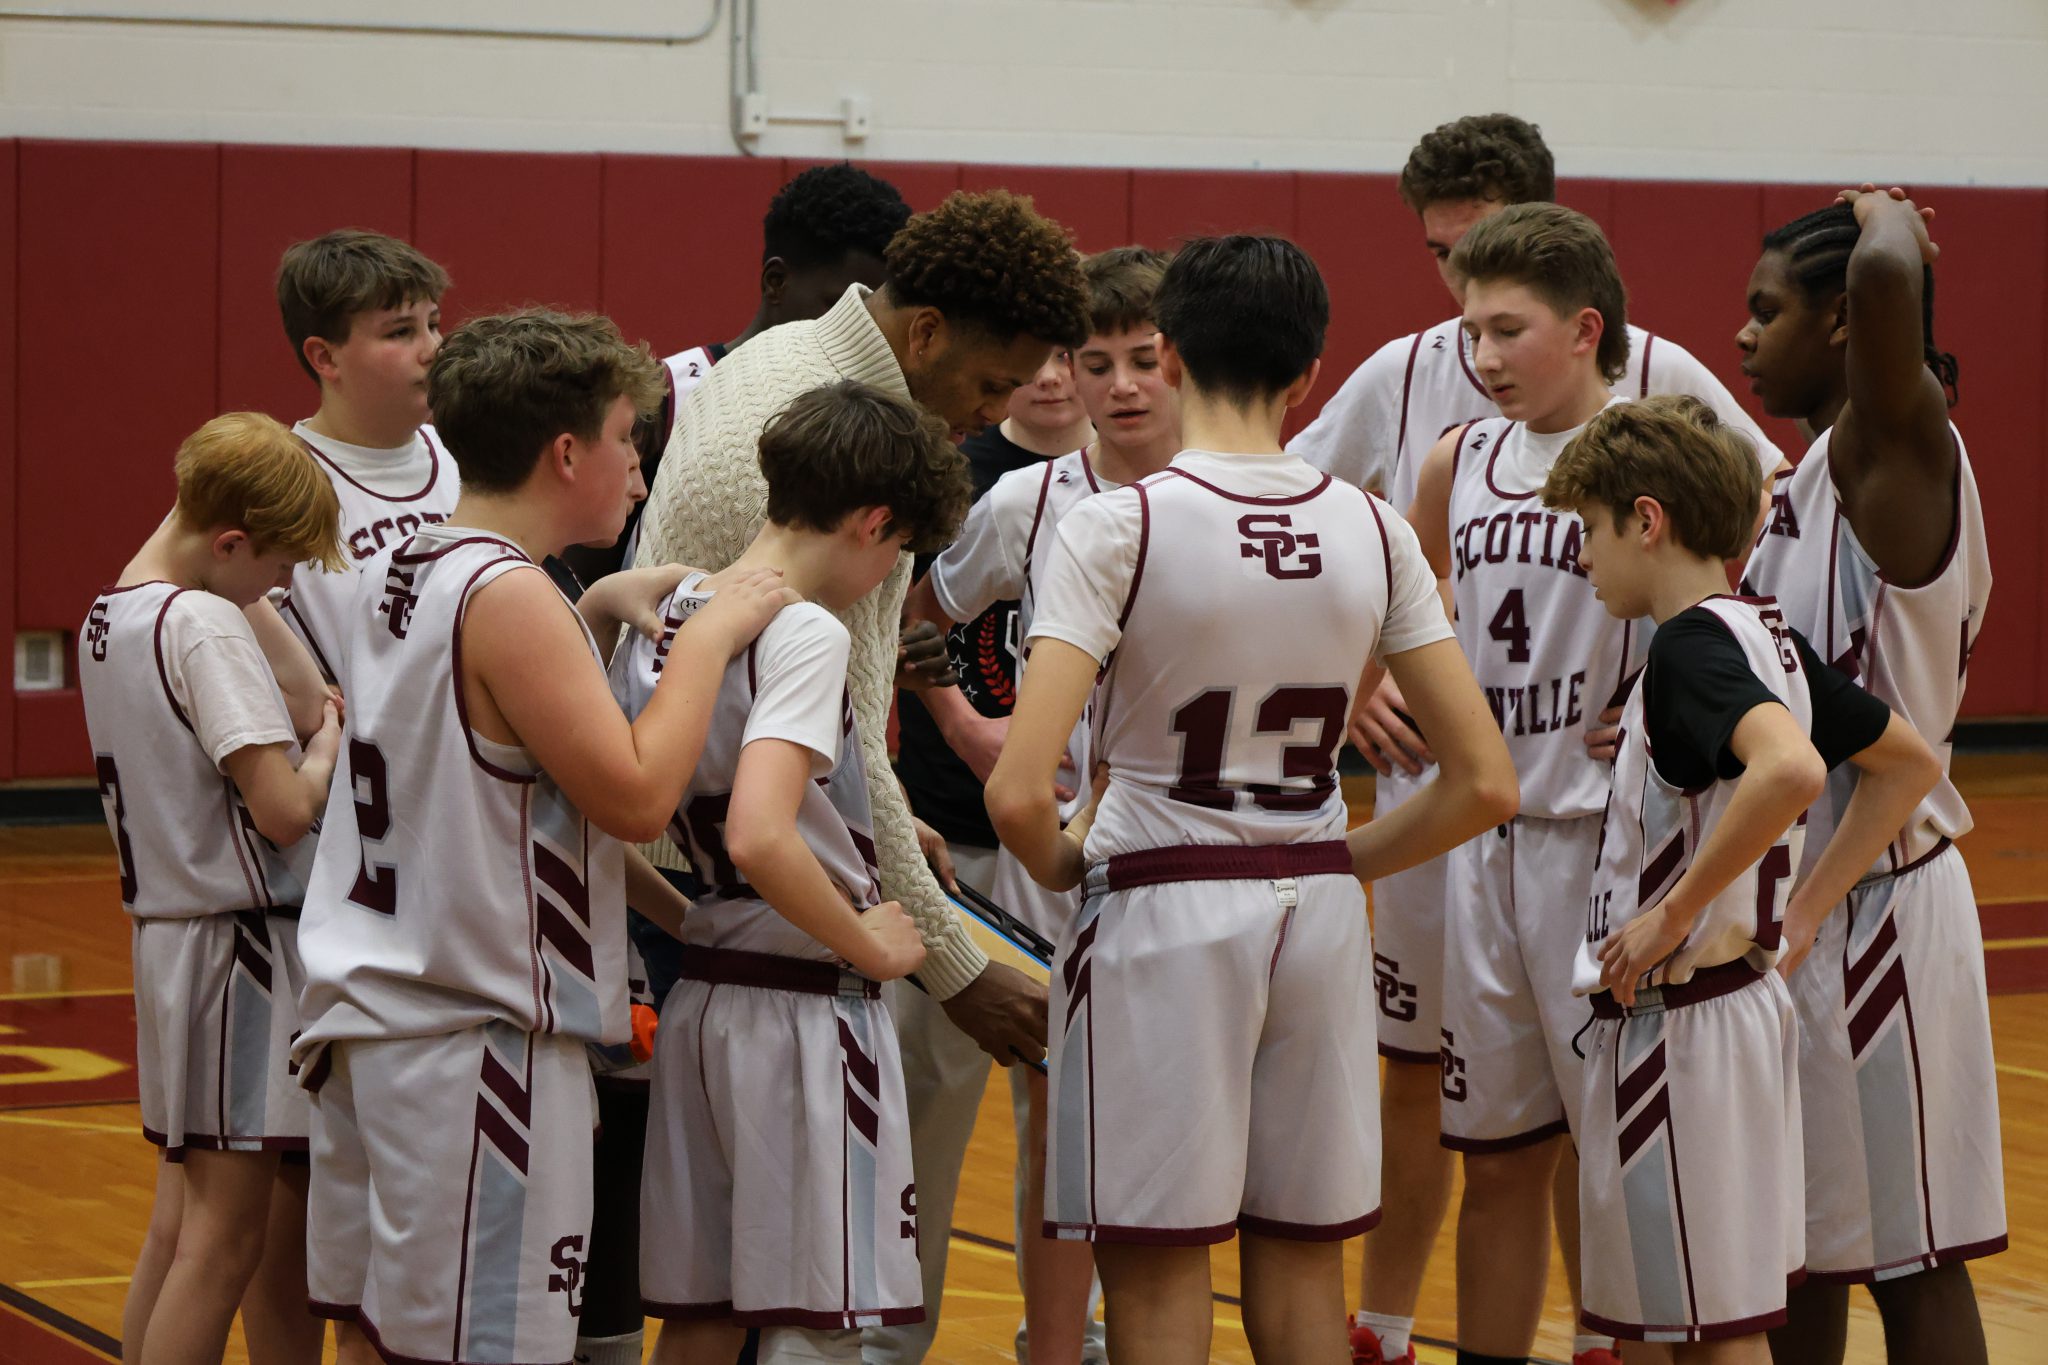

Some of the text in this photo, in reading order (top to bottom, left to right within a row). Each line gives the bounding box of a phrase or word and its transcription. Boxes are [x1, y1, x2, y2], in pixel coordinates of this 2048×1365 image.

[1237, 514, 1322, 580] SG
[1455, 512, 1588, 582] SCOTIA
[87, 603, 110, 662] SG
[1488, 589, 1531, 663] 4
[1167, 682, 1350, 816] 13
[347, 736, 398, 917] 2
[1373, 952, 1417, 1023] SG
